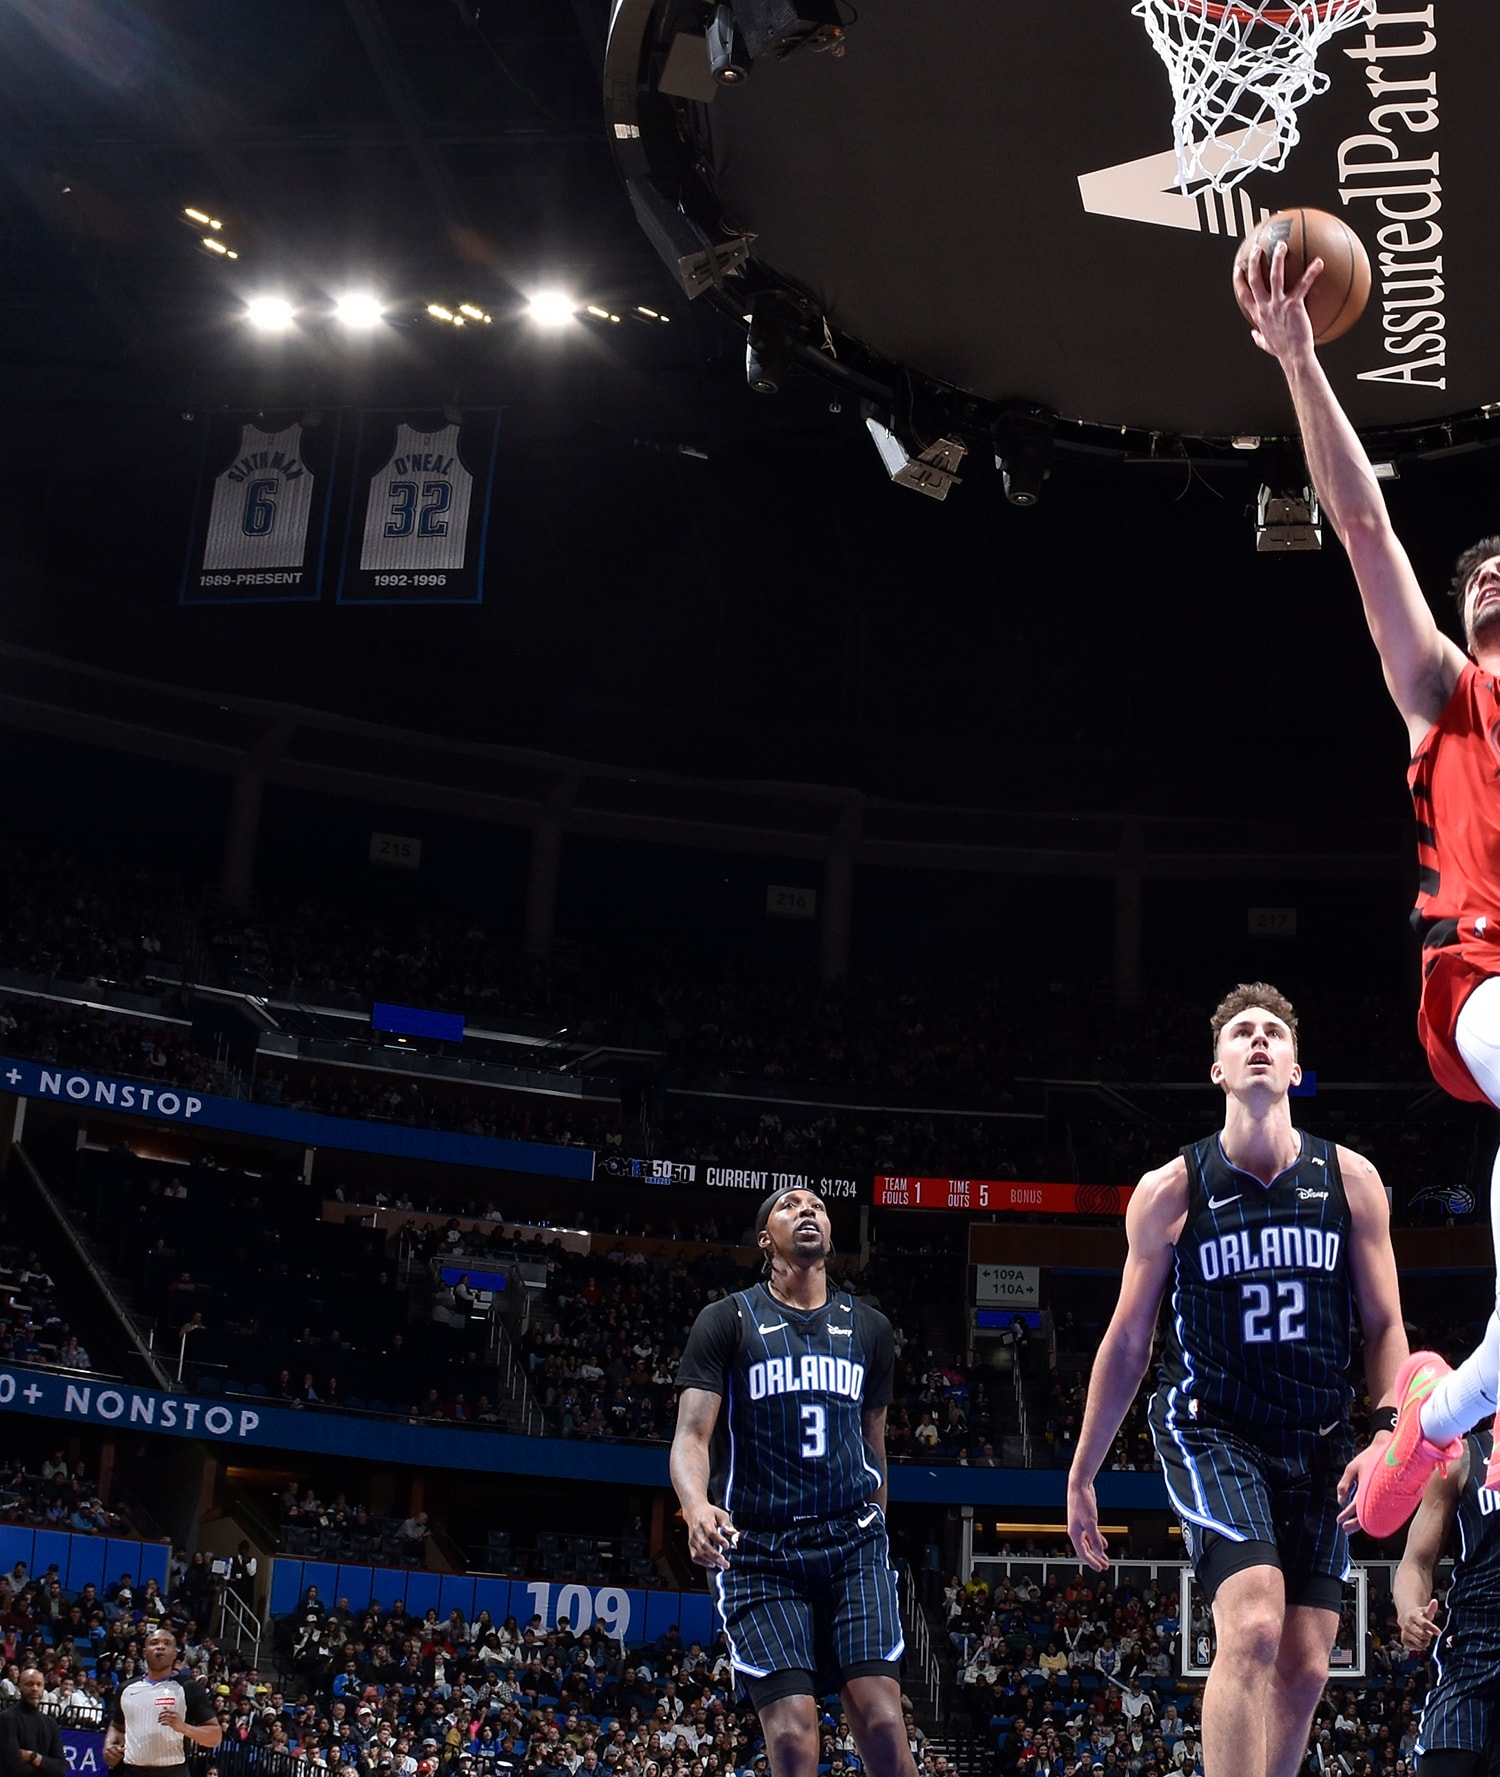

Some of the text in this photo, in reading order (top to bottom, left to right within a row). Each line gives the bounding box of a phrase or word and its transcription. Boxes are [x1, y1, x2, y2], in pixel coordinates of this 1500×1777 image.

[394, 453, 454, 475] O'NEAL
[242, 478, 279, 536] 6
[384, 481, 452, 538] 32
[200, 572, 303, 587] 1989-PRESENT
[374, 574, 447, 587] 1992-1996
[39, 1070, 202, 1118] NONSTOP
[706, 1166, 769, 1191] CURRENT
[819, 1176, 857, 1198] $1,734
[884, 1177, 907, 1190] TEAM
[914, 1182, 921, 1203] 1
[949, 1180, 970, 1194] TIME
[882, 1190, 909, 1205] FOULS
[947, 1194, 970, 1207] OUTS
[979, 1184, 989, 1207] 5
[1010, 1188, 1043, 1205] BONUS
[1296, 1187, 1329, 1200] Disney
[1199, 1225, 1341, 1281] ORLANDO
[993, 1269, 1025, 1281] 109A
[993, 1284, 1025, 1295] 110A
[1241, 1280, 1308, 1343] 22
[749, 1354, 864, 1401] ORLANDO
[64, 1384, 260, 1437] NONSTOP
[800, 1403, 826, 1459] 3
[527, 1581, 631, 1640] 109
